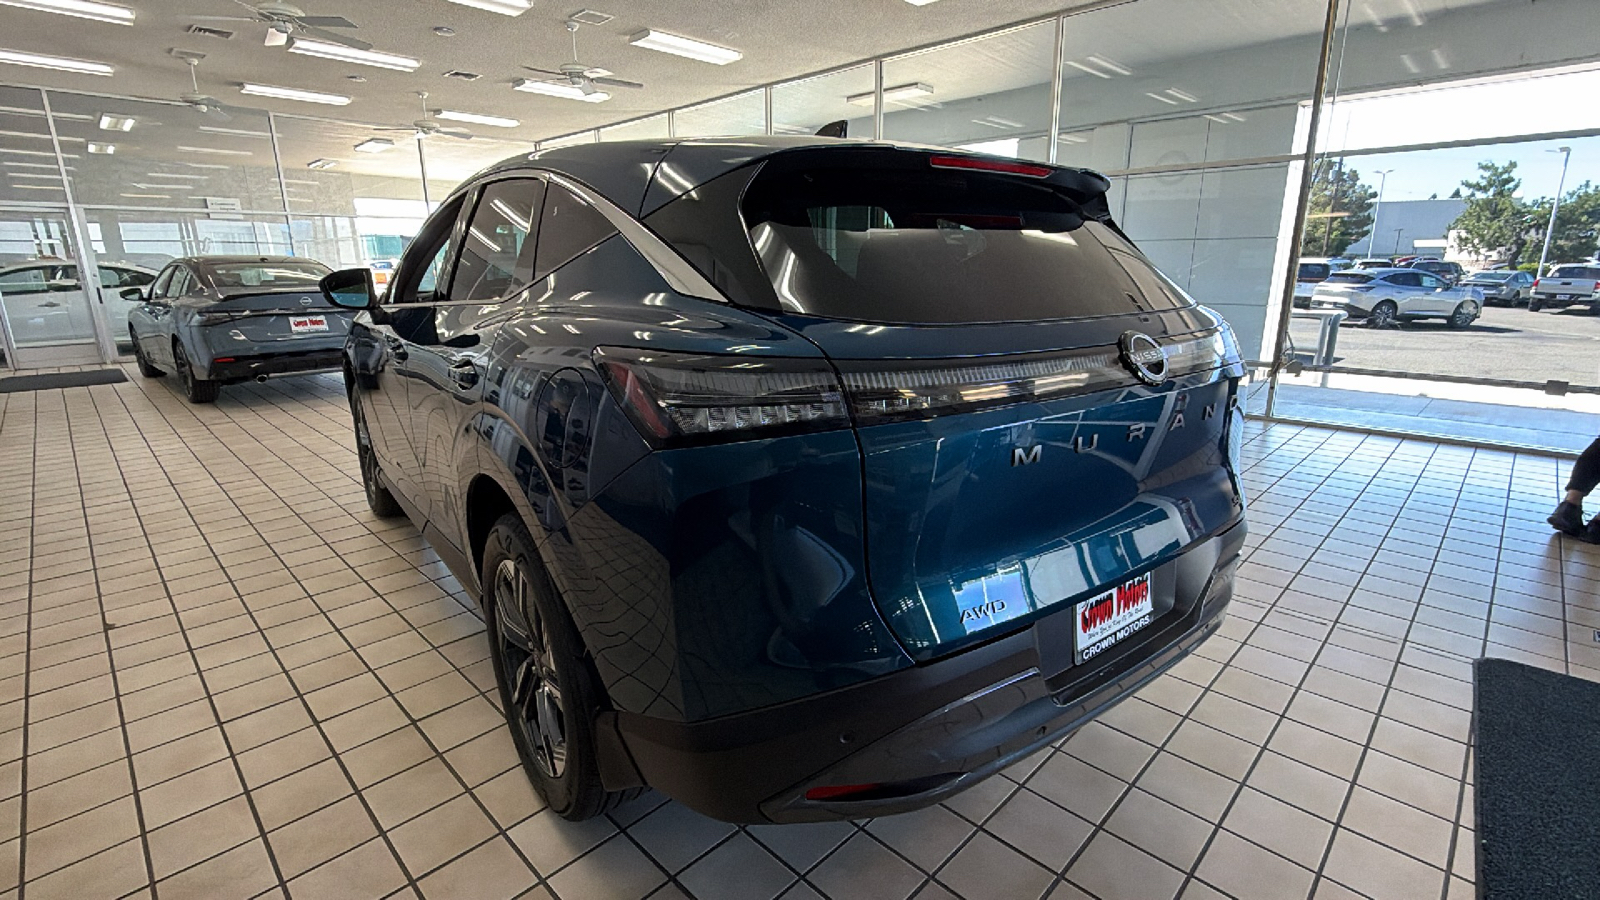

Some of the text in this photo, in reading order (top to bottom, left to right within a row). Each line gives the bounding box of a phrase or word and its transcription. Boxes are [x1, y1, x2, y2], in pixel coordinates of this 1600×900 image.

[960, 599, 1007, 624] AWD
[1081, 593, 1113, 633] Crown
[1117, 580, 1149, 617] Motors
[1083, 635, 1115, 660] CROWN
[1116, 614, 1150, 641] MOTORS
